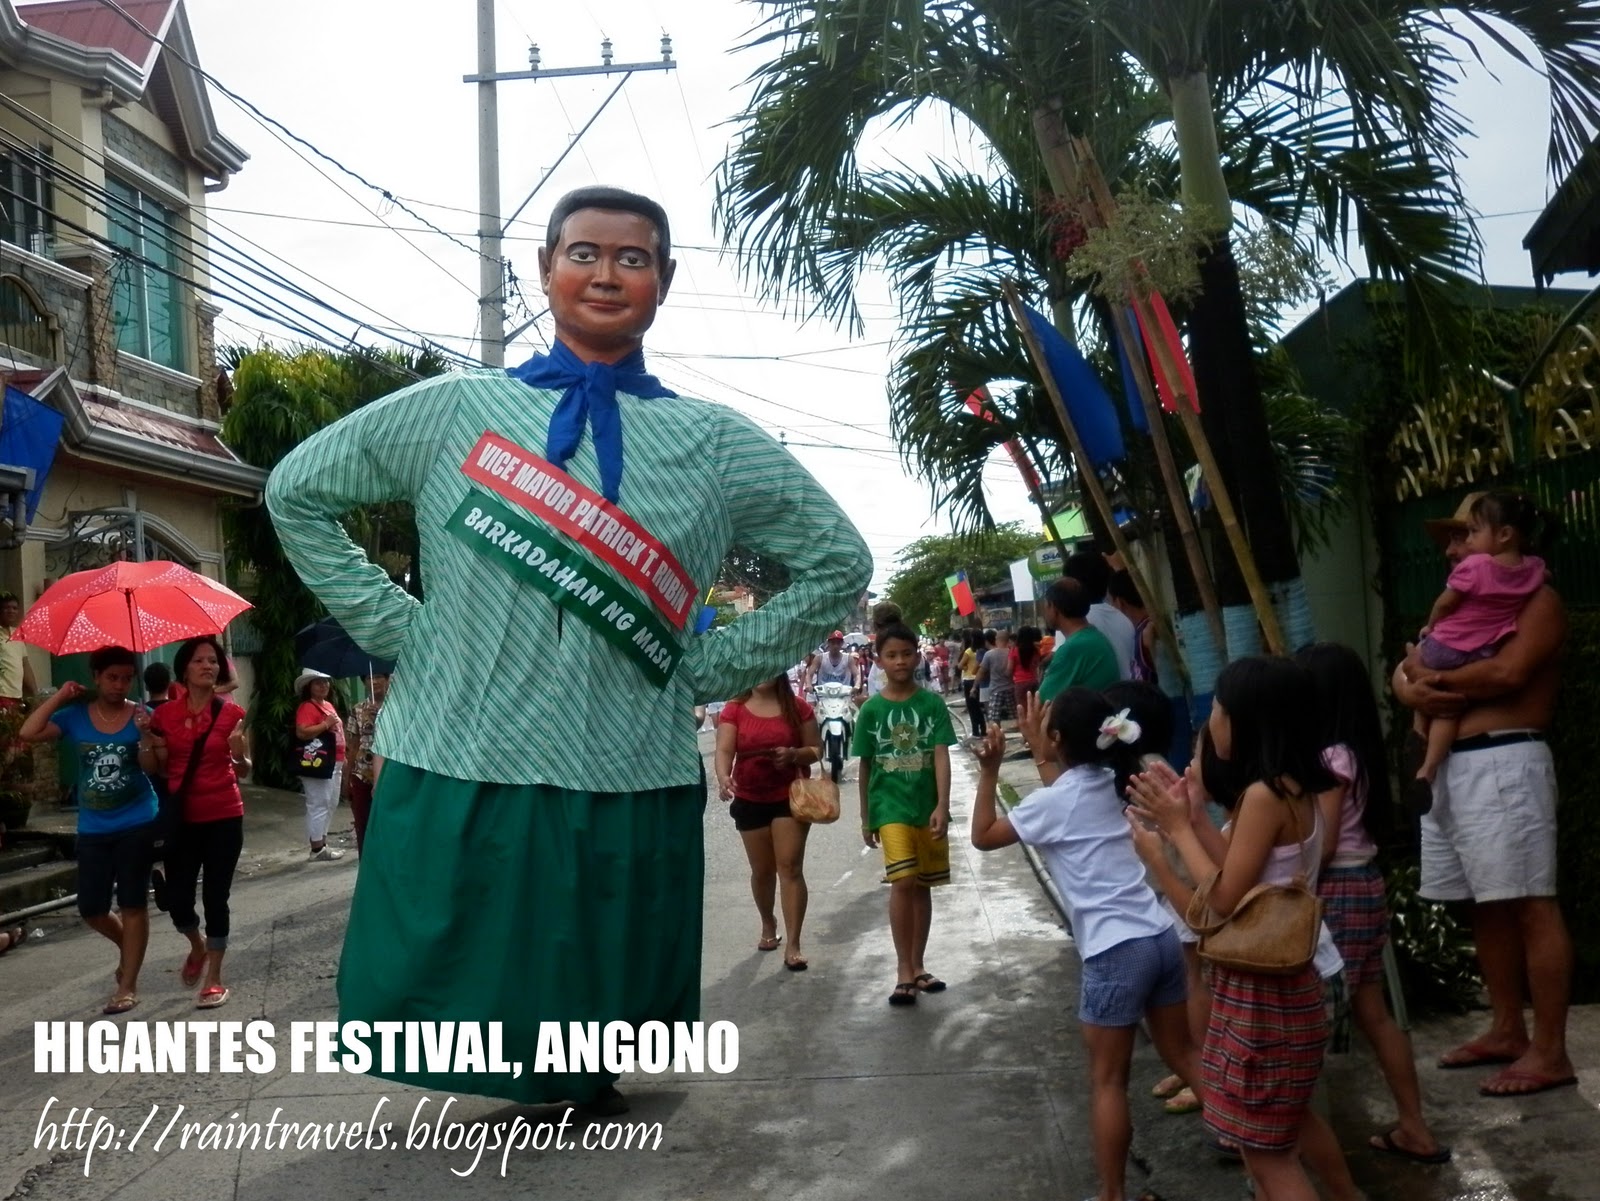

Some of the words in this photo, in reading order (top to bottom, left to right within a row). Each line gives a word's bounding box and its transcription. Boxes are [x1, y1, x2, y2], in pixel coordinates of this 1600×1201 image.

[464, 507, 605, 607] BARKADAHAN
[601, 601, 636, 631] NG
[632, 626, 673, 674] MASA
[476, 442, 521, 480] VICE
[511, 463, 576, 515] MAYOR
[570, 498, 647, 566] PATRICK
[640, 548, 659, 577] T.
[652, 561, 689, 614] RUBIN
